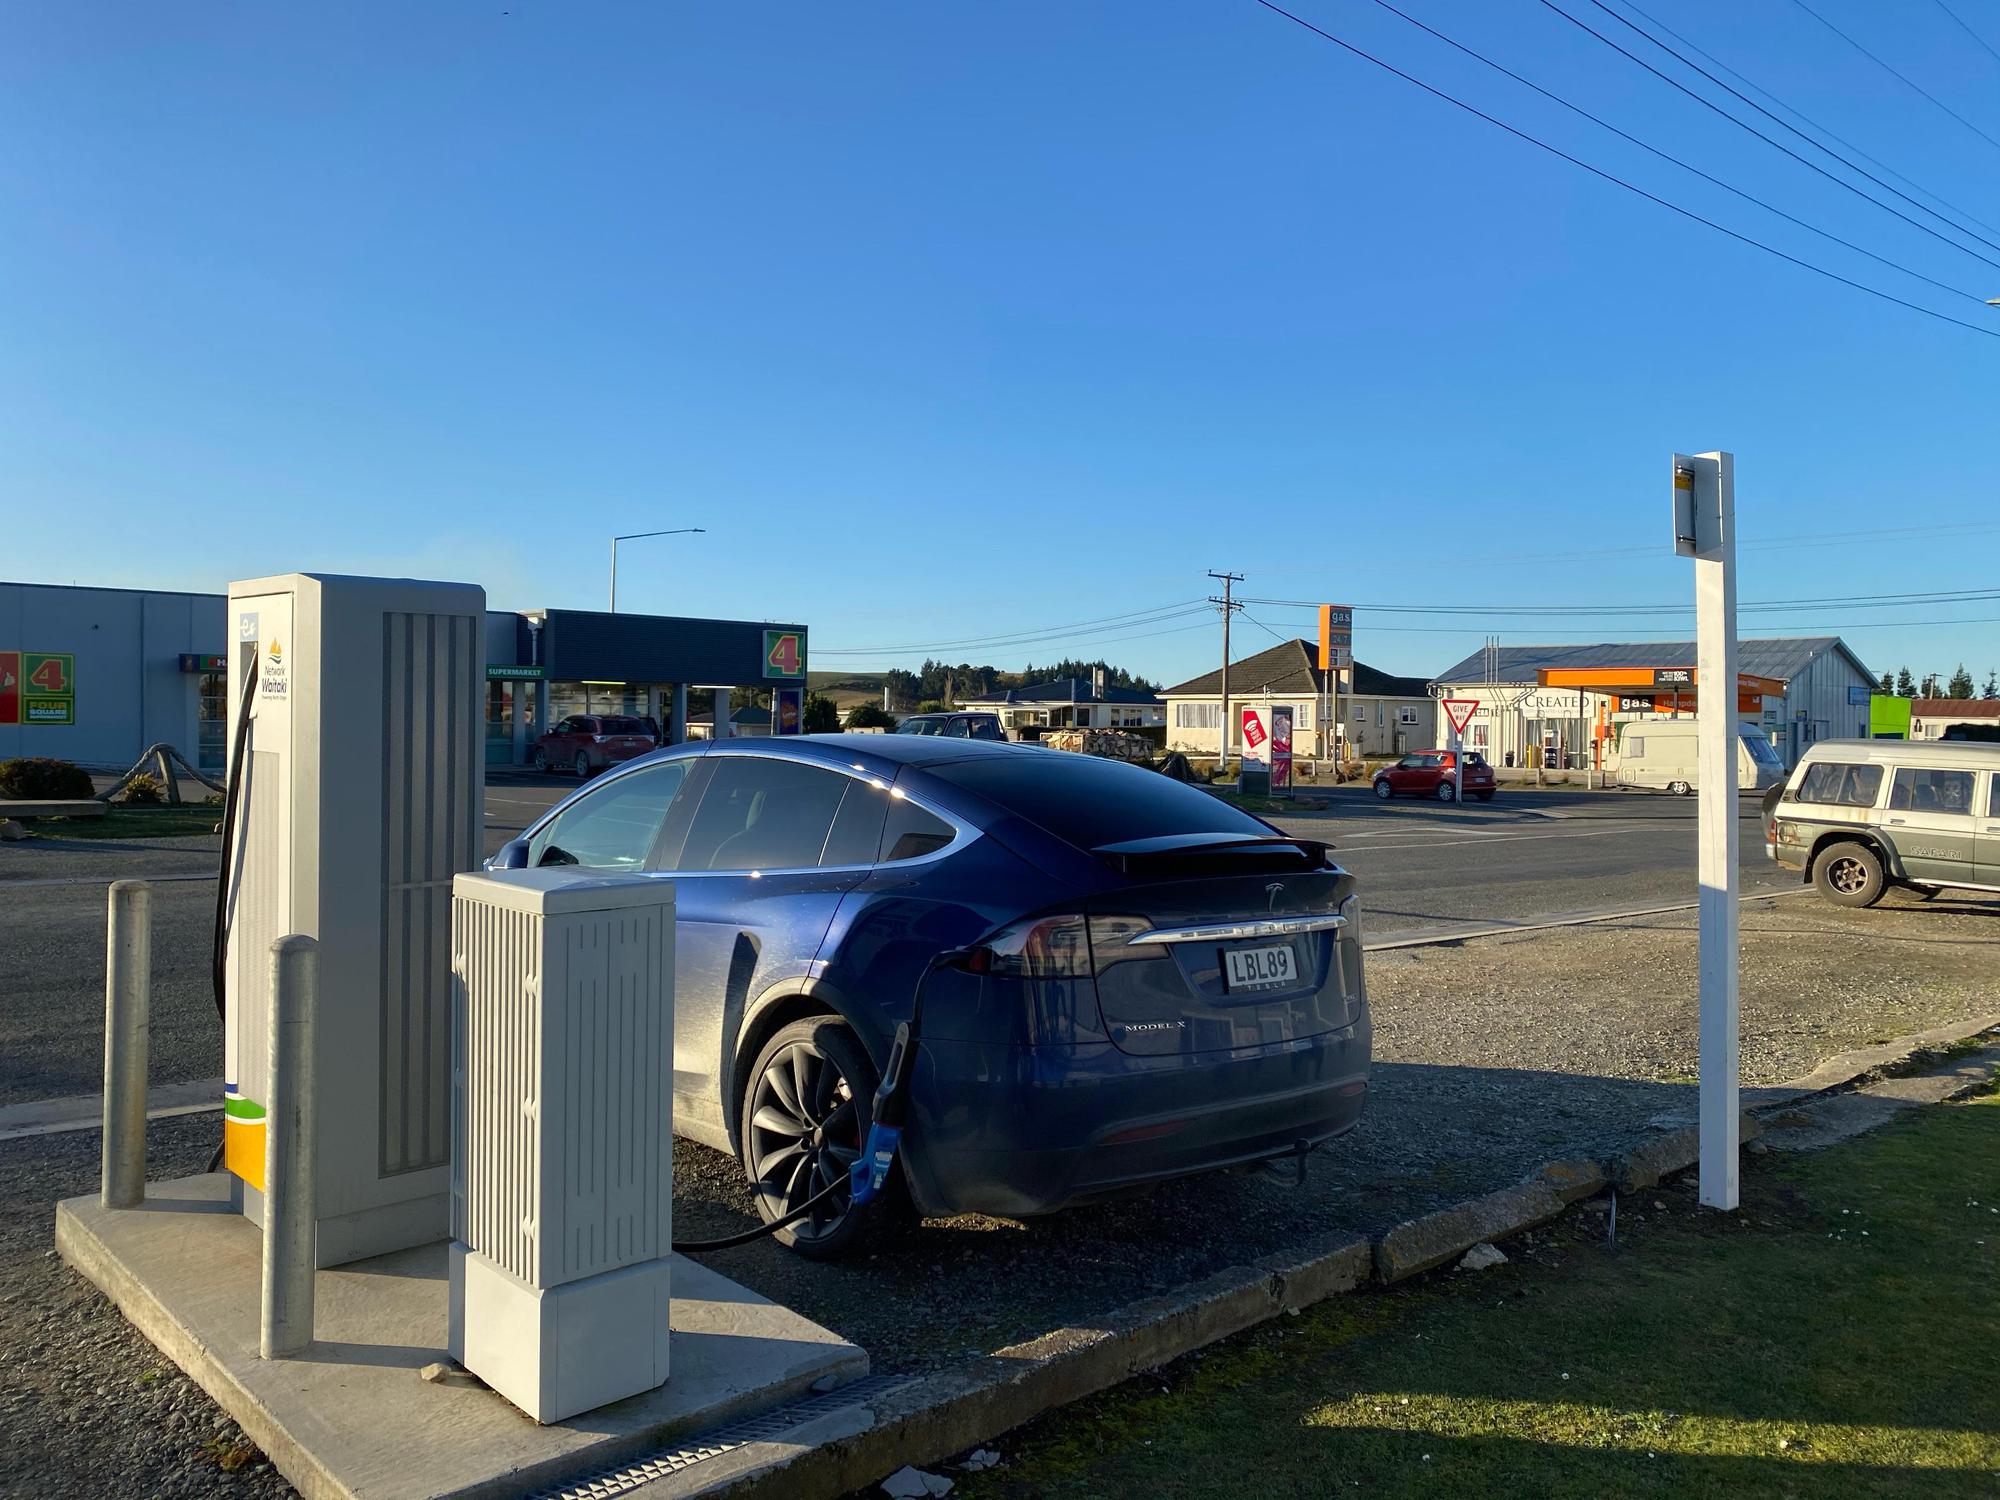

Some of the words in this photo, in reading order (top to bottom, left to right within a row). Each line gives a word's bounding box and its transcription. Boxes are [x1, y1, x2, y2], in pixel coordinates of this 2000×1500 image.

[767, 635, 802, 674] 4
[31, 658, 68, 691] 4
[264, 665, 286, 676] Network
[488, 668, 541, 676] SUPERMARKET
[261, 678, 288, 694] Waitaki
[1524, 694, 1590, 708] CREATED
[1452, 704, 1468, 713] GIVE
[1910, 845, 1962, 859] SAFARI
[1232, 950, 1288, 983] LBL89
[1124, 1023, 1174, 1032] MODEL
[1177, 1020, 1186, 1028] X
